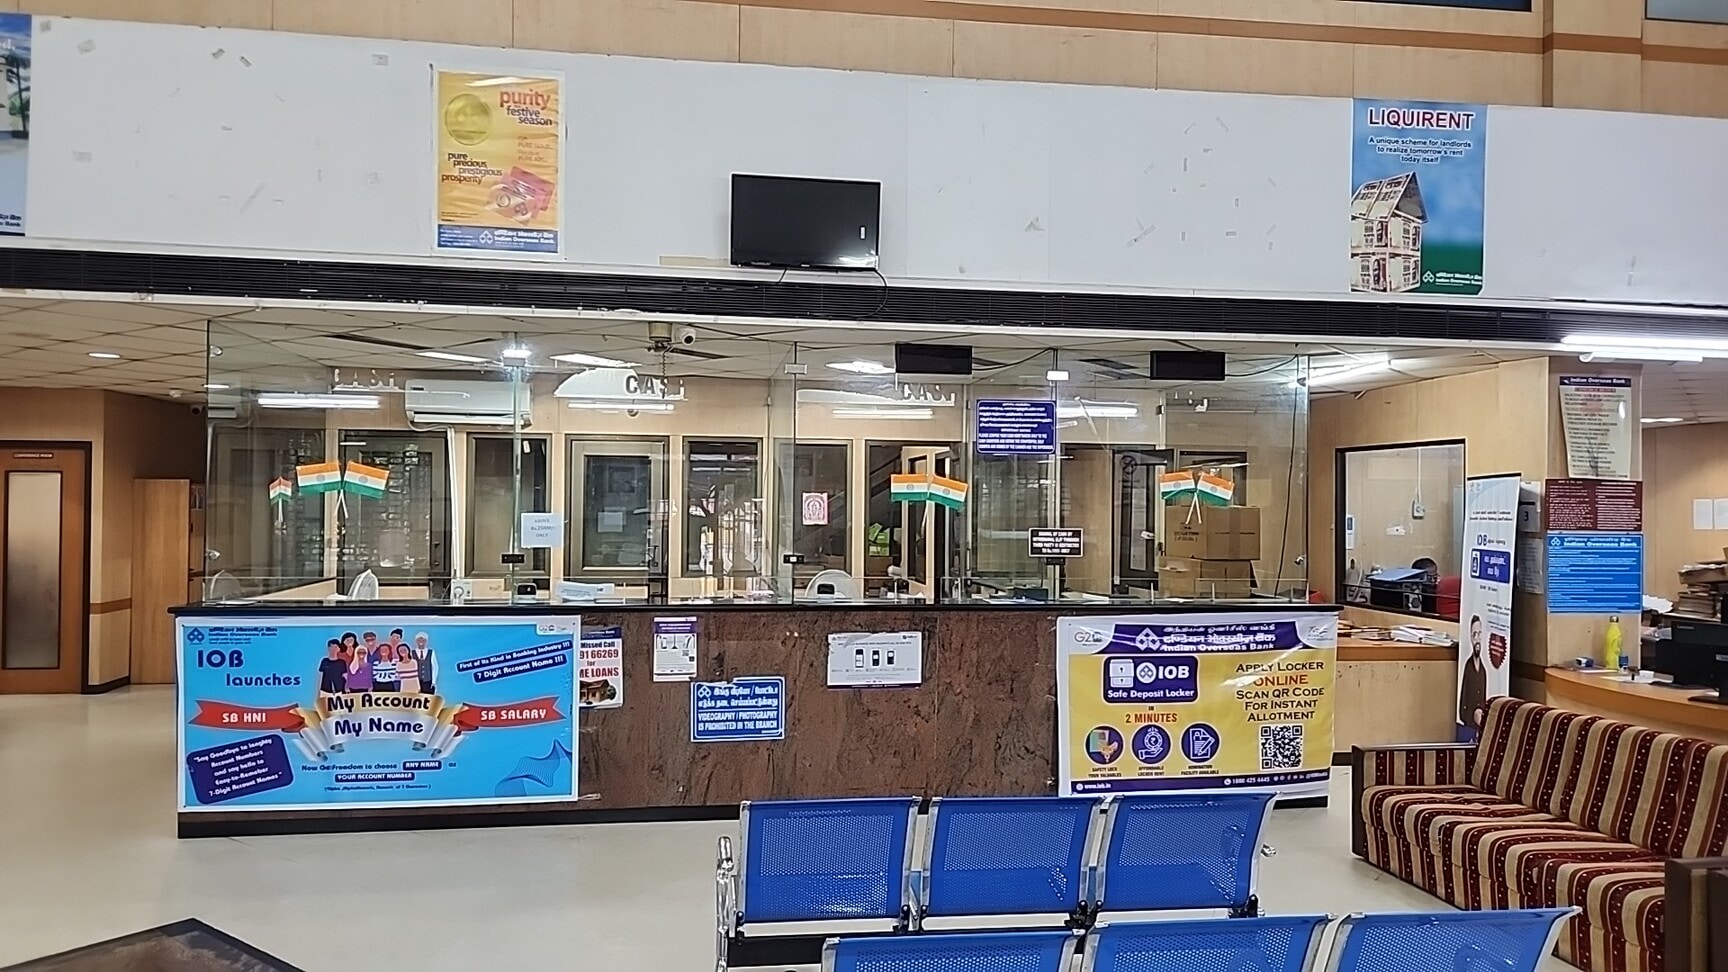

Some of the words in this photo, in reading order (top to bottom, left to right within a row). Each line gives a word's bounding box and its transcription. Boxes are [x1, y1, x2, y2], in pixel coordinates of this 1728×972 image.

[500, 88, 551, 111] purity
[507, 106, 541, 117] festive
[518, 116, 552, 126] season
[1369, 109, 1474, 129] LIQUIRENT
[1440, 140, 1471, 148] landlords
[448, 152, 468, 161] pure
[1402, 154, 1420, 163] today
[454, 158, 488, 168] precious
[459, 168, 503, 178] prestigious
[442, 174, 482, 185] prosperity
[198, 650, 244, 668] IOB
[460, 662, 473, 670] First
[490, 655, 505, 663] Kind
[512, 649, 538, 658] Banking
[538, 644, 562, 653] Industry
[484, 668, 502, 678] Digit
[503, 662, 532, 673] Account
[532, 658, 553, 668] Name
[591, 667, 619, 678] LOANS
[1158, 666, 1190, 679] IOB
[1236, 664, 1274, 673] APPLY
[1277, 662, 1324, 672] LOCKER
[226, 673, 301, 686] launches
[1254, 674, 1309, 687] ONLINE
[1108, 690, 1128, 698] Safe
[1130, 690, 1164, 700] Deposit
[1166, 689, 1195, 697] Locker
[1236, 690, 1269, 700] SCAN
[1272, 688, 1290, 699] QR
[1292, 687, 1325, 697] CODE
[328, 696, 355, 713] My
[362, 694, 431, 710] Account
[1245, 702, 1268, 711] FOR
[1270, 700, 1318, 710] INSTANT
[222, 713, 239, 723] SB
[243, 713, 266, 723] HNI
[481, 711, 496, 721] SB
[500, 709, 547, 720] SALARY
[698, 712, 736, 721] VIDEOGRAPHY
[739, 711, 778, 720] PHOTOGRAPHY
[1126, 714, 1131, 724] 2
[1134, 713, 1178, 723] MINUTES
[1247, 711, 1315, 722] ALLOTMENT
[335, 720, 362, 737] My
[369, 718, 424, 733] Name
[698, 723, 705, 731] IS
[705, 722, 737, 730] PROHIBITED
[737, 722, 743, 730] IN
[744, 721, 755, 730] THE
[756, 720, 778, 729] BRANCH
[210, 748, 240, 759] Goodbye
[211, 758, 235, 768] Account
[235, 750, 264, 761] Numbers
[214, 769, 227, 777] and
[240, 761, 256, 769] hello
[232, 780, 256, 791] Account
[256, 775, 279, 784] Names
